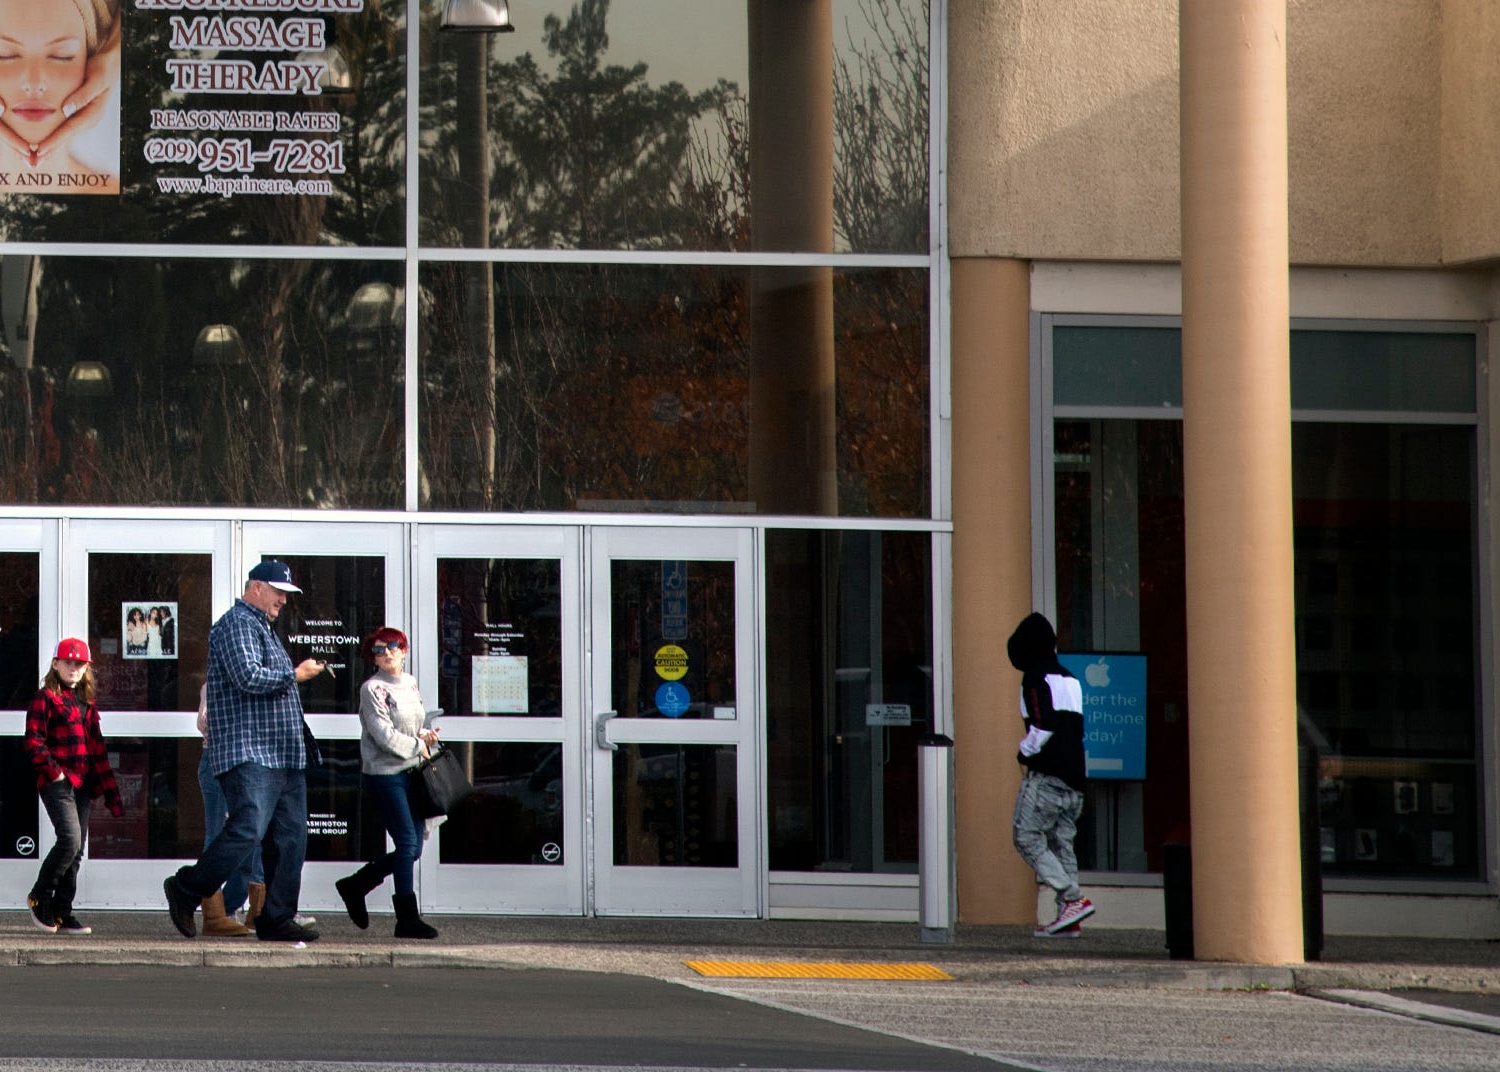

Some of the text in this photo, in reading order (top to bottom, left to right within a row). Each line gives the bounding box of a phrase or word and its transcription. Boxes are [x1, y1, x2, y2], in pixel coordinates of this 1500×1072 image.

[171, 18, 325, 49] MASSAGE
[167, 61, 325, 93] THERAPY
[152, 110, 340, 131] REASONABLE RATES!
[145, 141, 346, 173] (209) 951-7281
[16, 172, 54, 187] AND
[57, 172, 111, 189] ENJOY
[157, 174, 332, 197] www.bapaincare.com
[288, 635, 360, 645] WEBERSTOWN
[1110, 692, 1137, 706] the
[1087, 711, 1145, 725] iPhone
[1082, 729, 1124, 745] oday!
